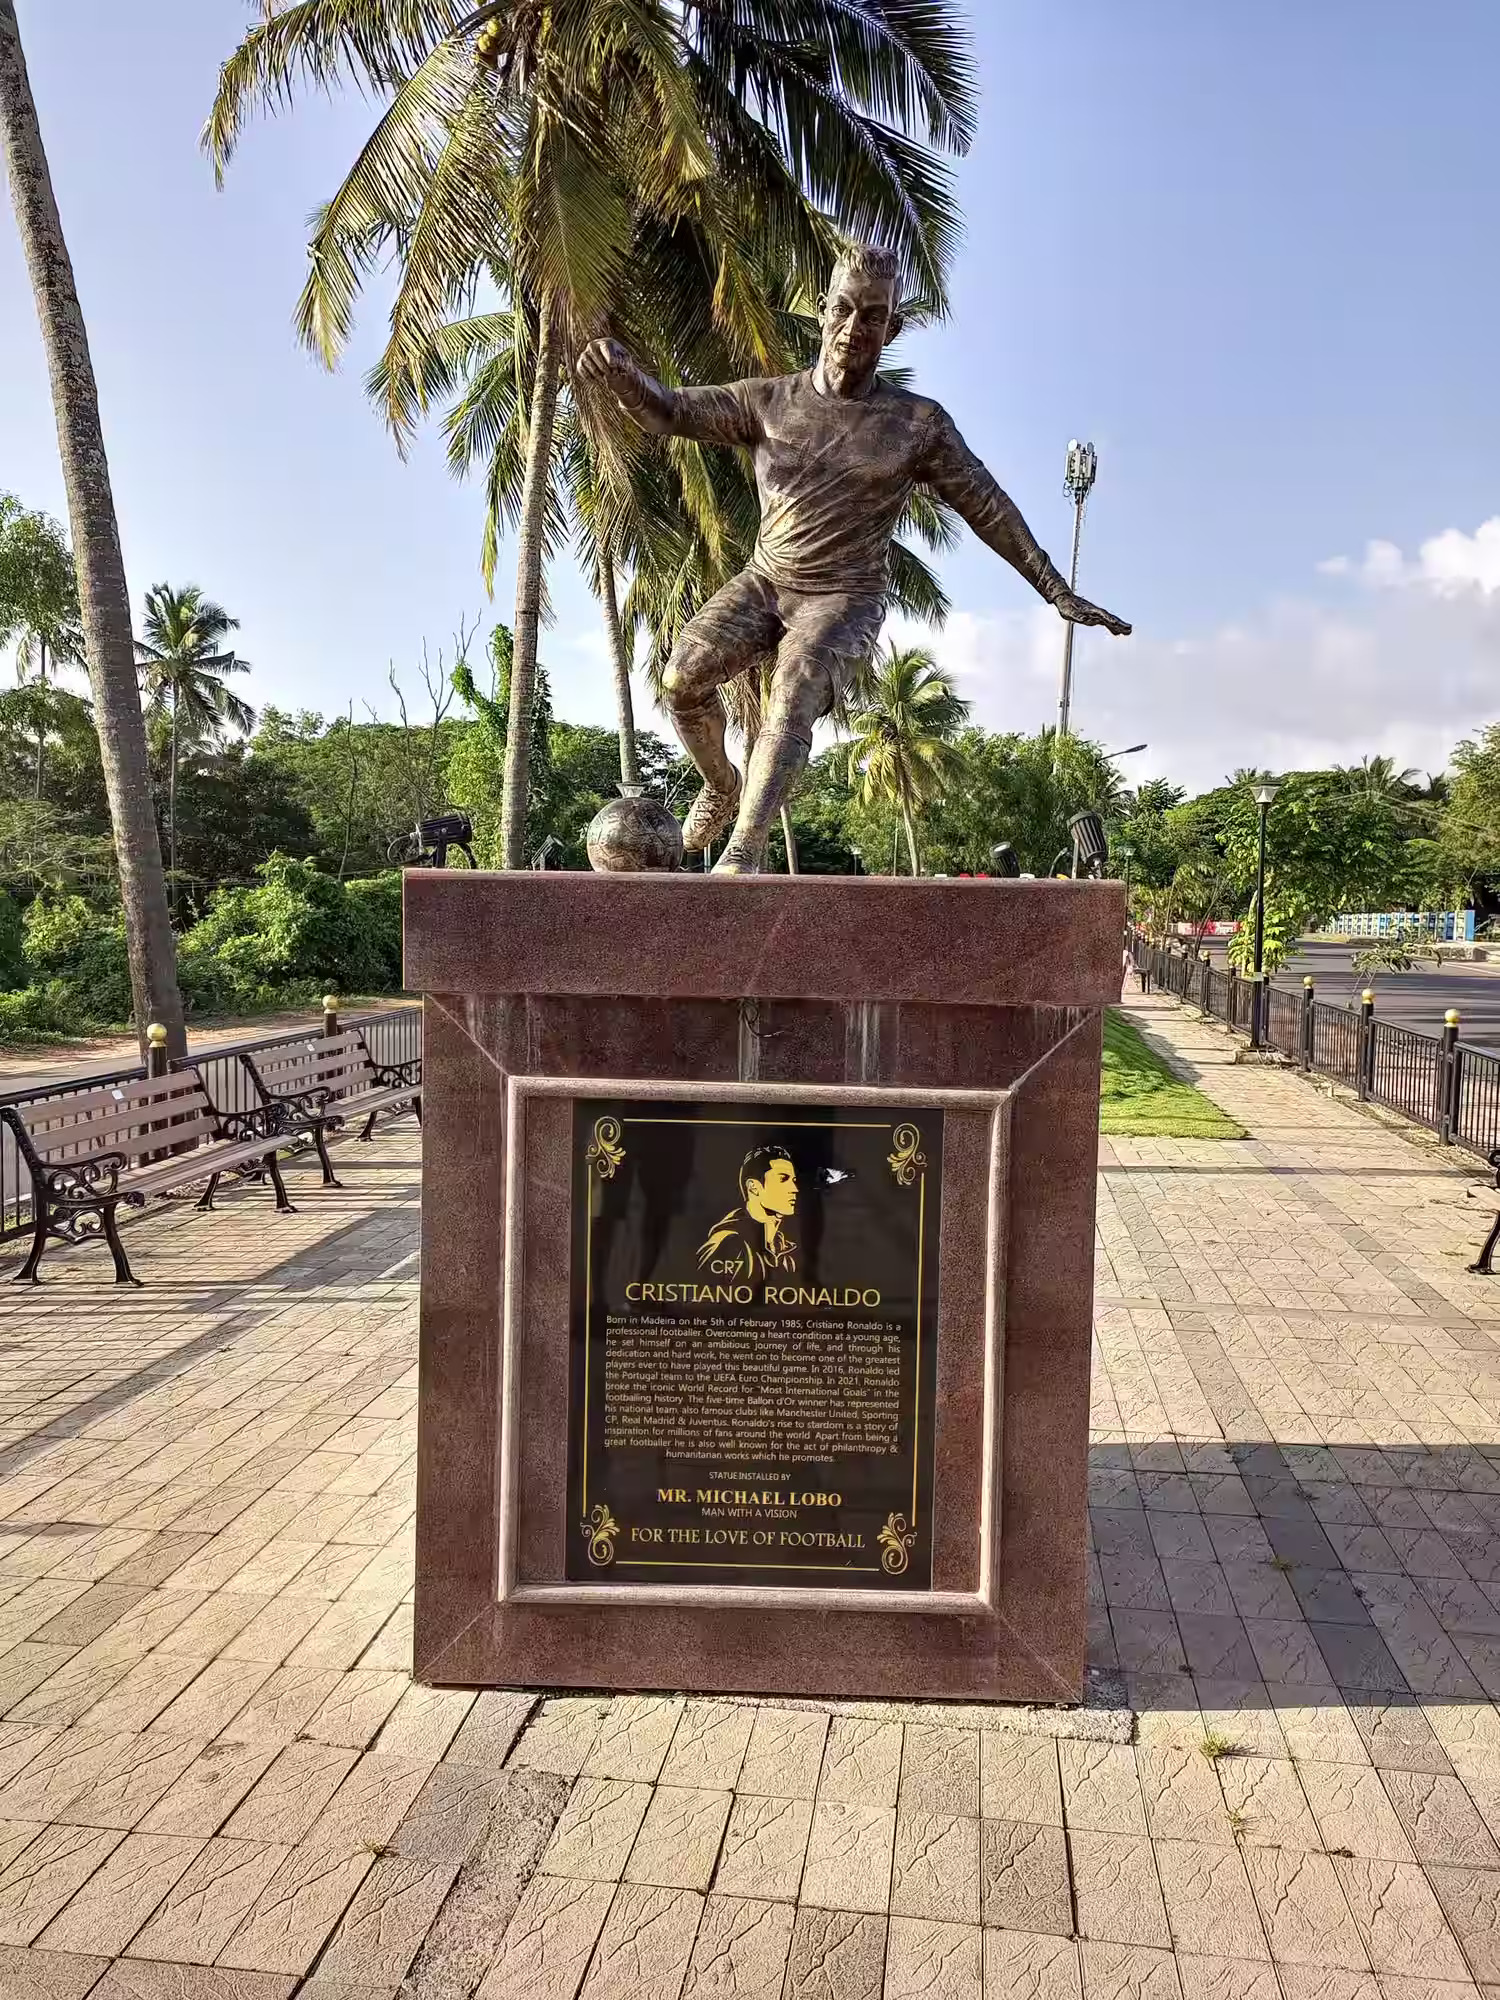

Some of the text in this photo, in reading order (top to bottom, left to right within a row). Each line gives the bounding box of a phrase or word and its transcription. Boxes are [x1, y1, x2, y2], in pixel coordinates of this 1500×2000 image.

[710, 1258, 745, 1281] CR7
[625, 1283, 881, 1307] CRISTIANO RONALDO
[605, 1314, 626, 1325] Born
[629, 1315, 639, 1325] in
[640, 1315, 676, 1326] Madeira
[678, 1318, 690, 1326] on
[692, 1316, 707, 1327] the
[710, 1317, 724, 1327] 5th
[726, 1317, 736, 1327] of
[738, 1317, 777, 1331] February
[805, 1319, 844, 1330] Cristiano
[846, 1320, 883, 1330] Ronaldo
[885, 1321, 892, 1331] is
[605, 1326, 658, 1340] professional
[704, 1328, 758, 1342] Overcoming
[766, 1330, 790, 1340] heart
[791, 1330, 833, 1341] condition
[834, 1332, 844, 1341] at
[852, 1333, 880, 1345] young
[605, 1336, 902, 1355] he set himself on an ambitious journey of and through his
[604, 1348, 650, 1359] dedication
[652, 1349, 669, 1359] and
[670, 1349, 691, 1360] hard
[718, 1350, 730, 1360] he
[731, 1352, 754, 1361] went
[754, 1353, 767, 1361] on
[769, 1352, 779, 1362] to
[780, 1352, 816, 1362] become
[817, 1355, 835, 1363] one
[836, 1353, 846, 1363] of
[848, 1353, 862, 1364] the
[864, 1355, 901, 1367] greatest
[604, 1358, 636, 1372] players
[637, 1361, 656, 1370] ever
[658, 1361, 668, 1370] to
[670, 1360, 691, 1370] have
[692, 1361, 722, 1374] played
[724, 1361, 740, 1372] this
[742, 1362, 780, 1373] beautiful
[810, 1363, 820, 1374] In
[847, 1364, 884, 1375] Ronaldo
[886, 1365, 900, 1376] led
[604, 1370, 900, 1386] the Portugal team to the UEFA Euro In Ronaldo
[604, 1381, 630, 1391] broke
[632, 1381, 647, 1392] the
[649, 1382, 675, 1392] iconic
[678, 1382, 704, 1393] World
[707, 1383, 738, 1394] Record
[740, 1384, 754, 1394] for
[784, 1385, 840, 1396] International
[872, 1387, 883, 1397] in
[884, 1387, 900, 1397] the
[604, 1392, 652, 1406] footballing
[687, 1394, 705, 1404] The
[746, 1395, 774, 1406] Ballon
[796, 1397, 828, 1407] winner
[829, 1397, 845, 1407] has
[846, 1397, 900, 1411] represented
[604, 1403, 900, 1422] his national also famous clubs like Manchester Sporting
[621, 1415, 640, 1425] Real
[642, 1415, 675, 1426] Madrid
[794, 1419, 804, 1428] to
[806, 1418, 844, 1429] stardom
[846, 1419, 854, 1429] is
[863, 1421, 886, 1433] story
[887, 1420, 900, 1430] of
[604, 1425, 649, 1438] inspiration
[651, 1426, 664, 1436] for
[666, 1426, 700, 1437] millions
[702, 1427, 712, 1437] of
[714, 1427, 733, 1438] fans
[734, 1428, 766, 1438] around
[768, 1428, 783, 1439] the
[814, 1429, 839, 1443] Apart
[841, 1430, 862, 1440] from
[864, 1431, 890, 1444] being
[604, 1437, 626, 1449] great
[674, 1438, 685, 1448] he
[687, 1438, 695, 1448] is
[697, 1438, 716, 1449] also
[718, 1439, 736, 1449] well
[738, 1439, 768, 1450] known
[770, 1440, 783, 1450] for
[785, 1441, 800, 1451] the
[802, 1442, 816, 1451] act
[818, 1441, 829, 1451] of
[831, 1442, 886, 1456] philanthropy
[723, 1450, 790, 1461] works which he
[708, 1471, 792, 1481] STATUE INSTALLED BY
[656, 1488, 843, 1507] MR. MICHAEL LOBO
[701, 1507, 798, 1519] MAN WITH A VISION
[630, 1527, 866, 1549] FOR THE LOVE OF FOOTBALL
